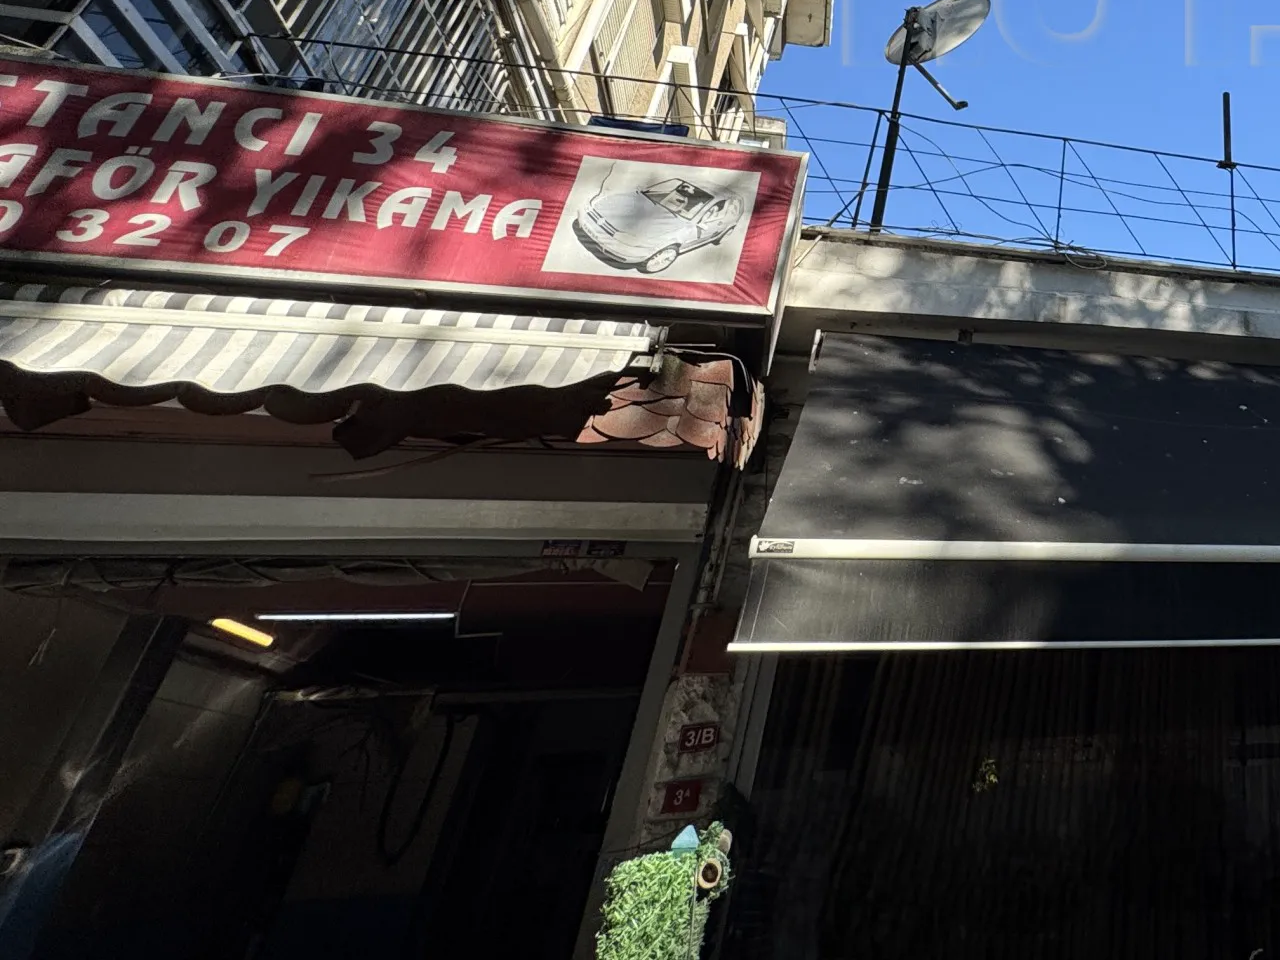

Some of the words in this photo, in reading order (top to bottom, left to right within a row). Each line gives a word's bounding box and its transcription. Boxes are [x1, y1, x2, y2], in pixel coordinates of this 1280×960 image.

[0, 75, 323, 156] TANCI
[353, 121, 460, 175] 34
[56, 209, 172, 247] 32
[203, 220, 311, 257] 07
[246, 168, 544, 241] YIKAMA
[685, 727, 715, 747] 3/B
